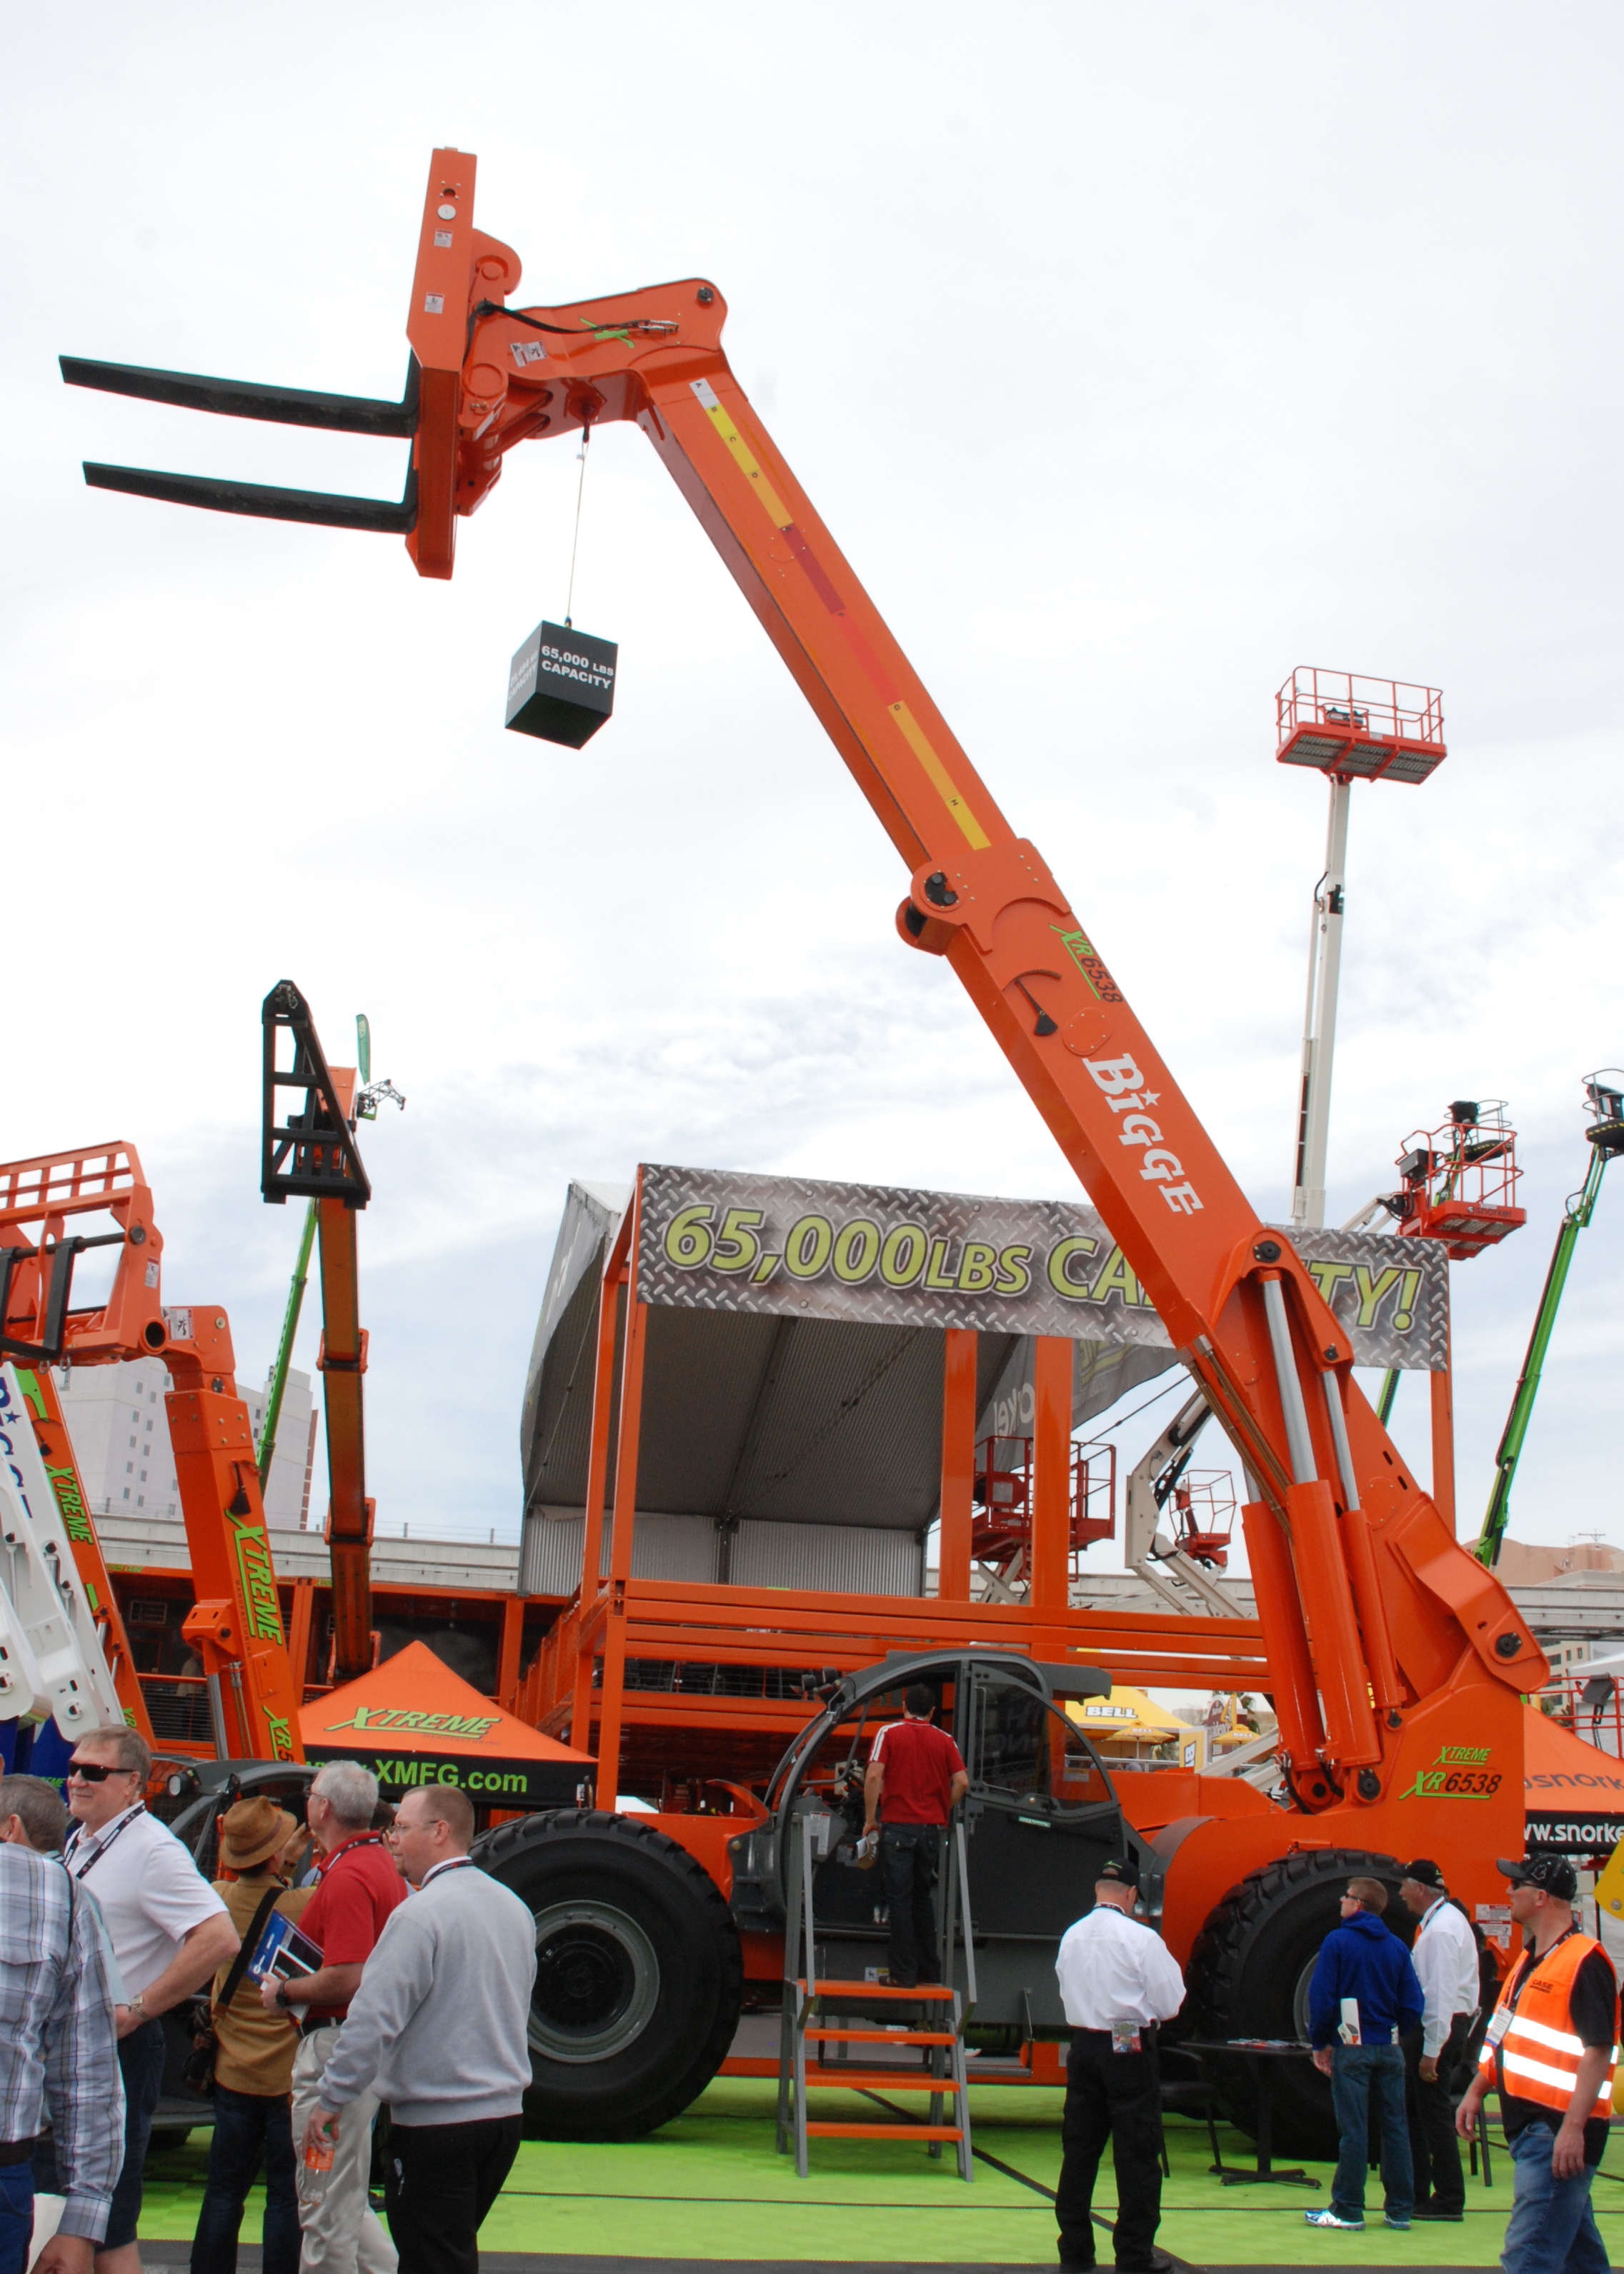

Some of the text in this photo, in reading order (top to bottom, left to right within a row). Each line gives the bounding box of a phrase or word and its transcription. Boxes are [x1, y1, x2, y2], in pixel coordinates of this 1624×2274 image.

[541, 645, 589, 669] 65,000
[592, 662, 614, 677] LBS
[542, 659, 612, 690] CAPACITY
[1048, 923, 1124, 1003] XR6538
[1046, 1233, 1425, 1335] CATY!
[224, 1508, 283, 1646] XTREME
[324, 1706, 503, 1739] XTREME
[1085, 1705, 1138, 1719] BELL
[1431, 1745, 1493, 1767] XTREME
[1398, 1770, 1503, 1800] XR6538
